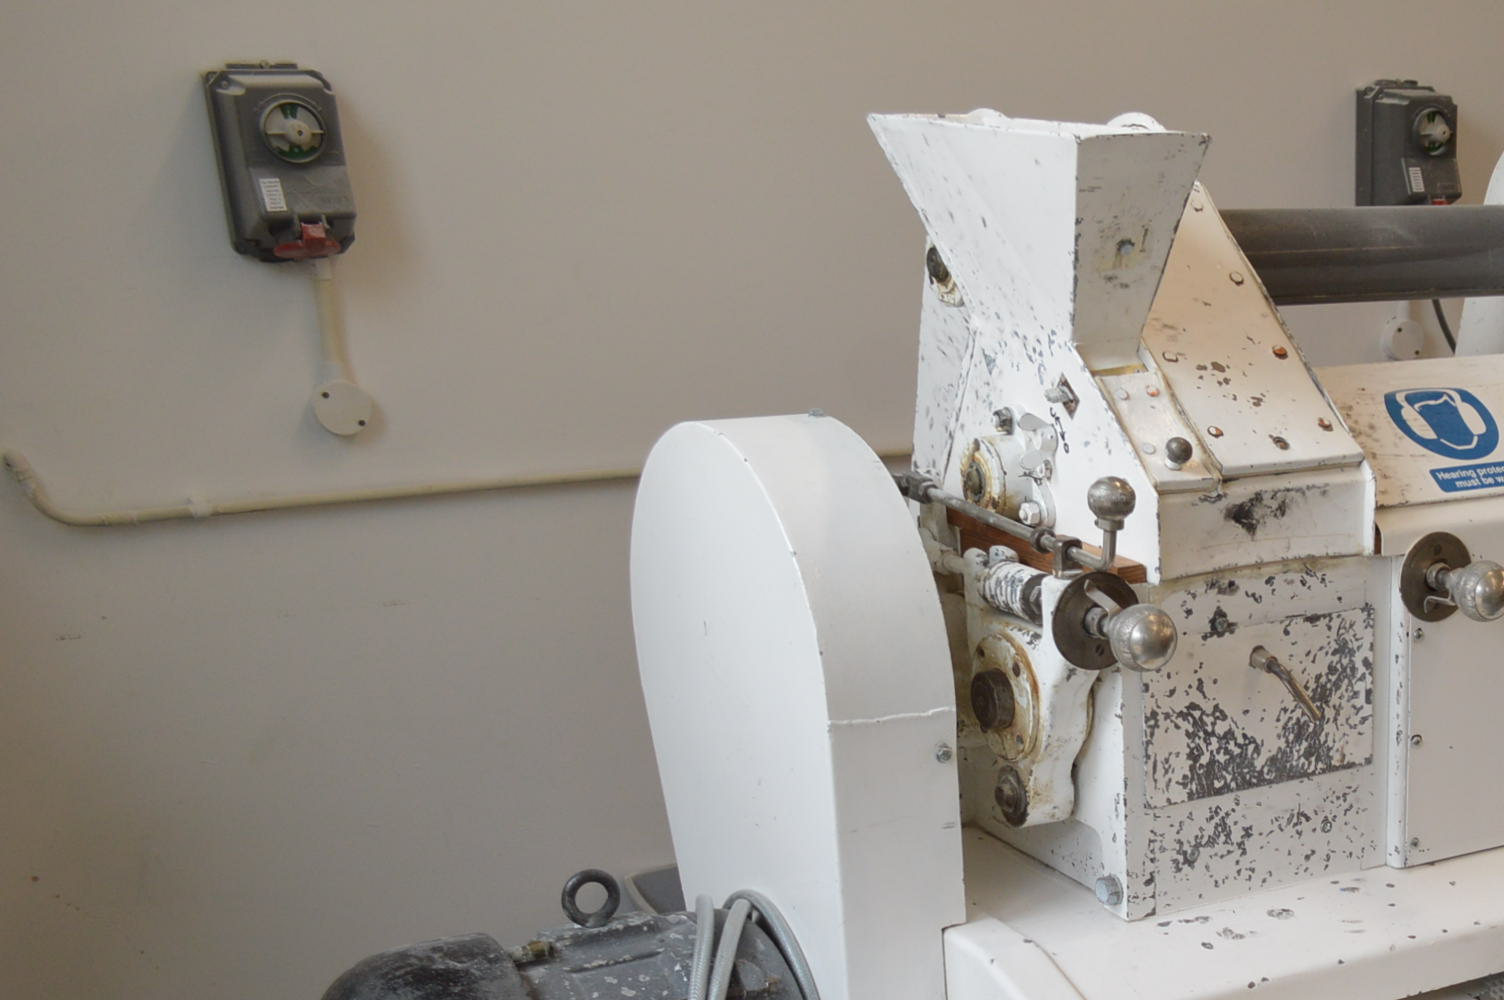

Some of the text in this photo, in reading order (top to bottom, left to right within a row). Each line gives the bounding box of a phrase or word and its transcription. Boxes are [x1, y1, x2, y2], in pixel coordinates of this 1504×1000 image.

[1436, 468, 1477, 481] Hearing
[1455, 477, 1481, 488] must
[1481, 475, 1495, 485] be
